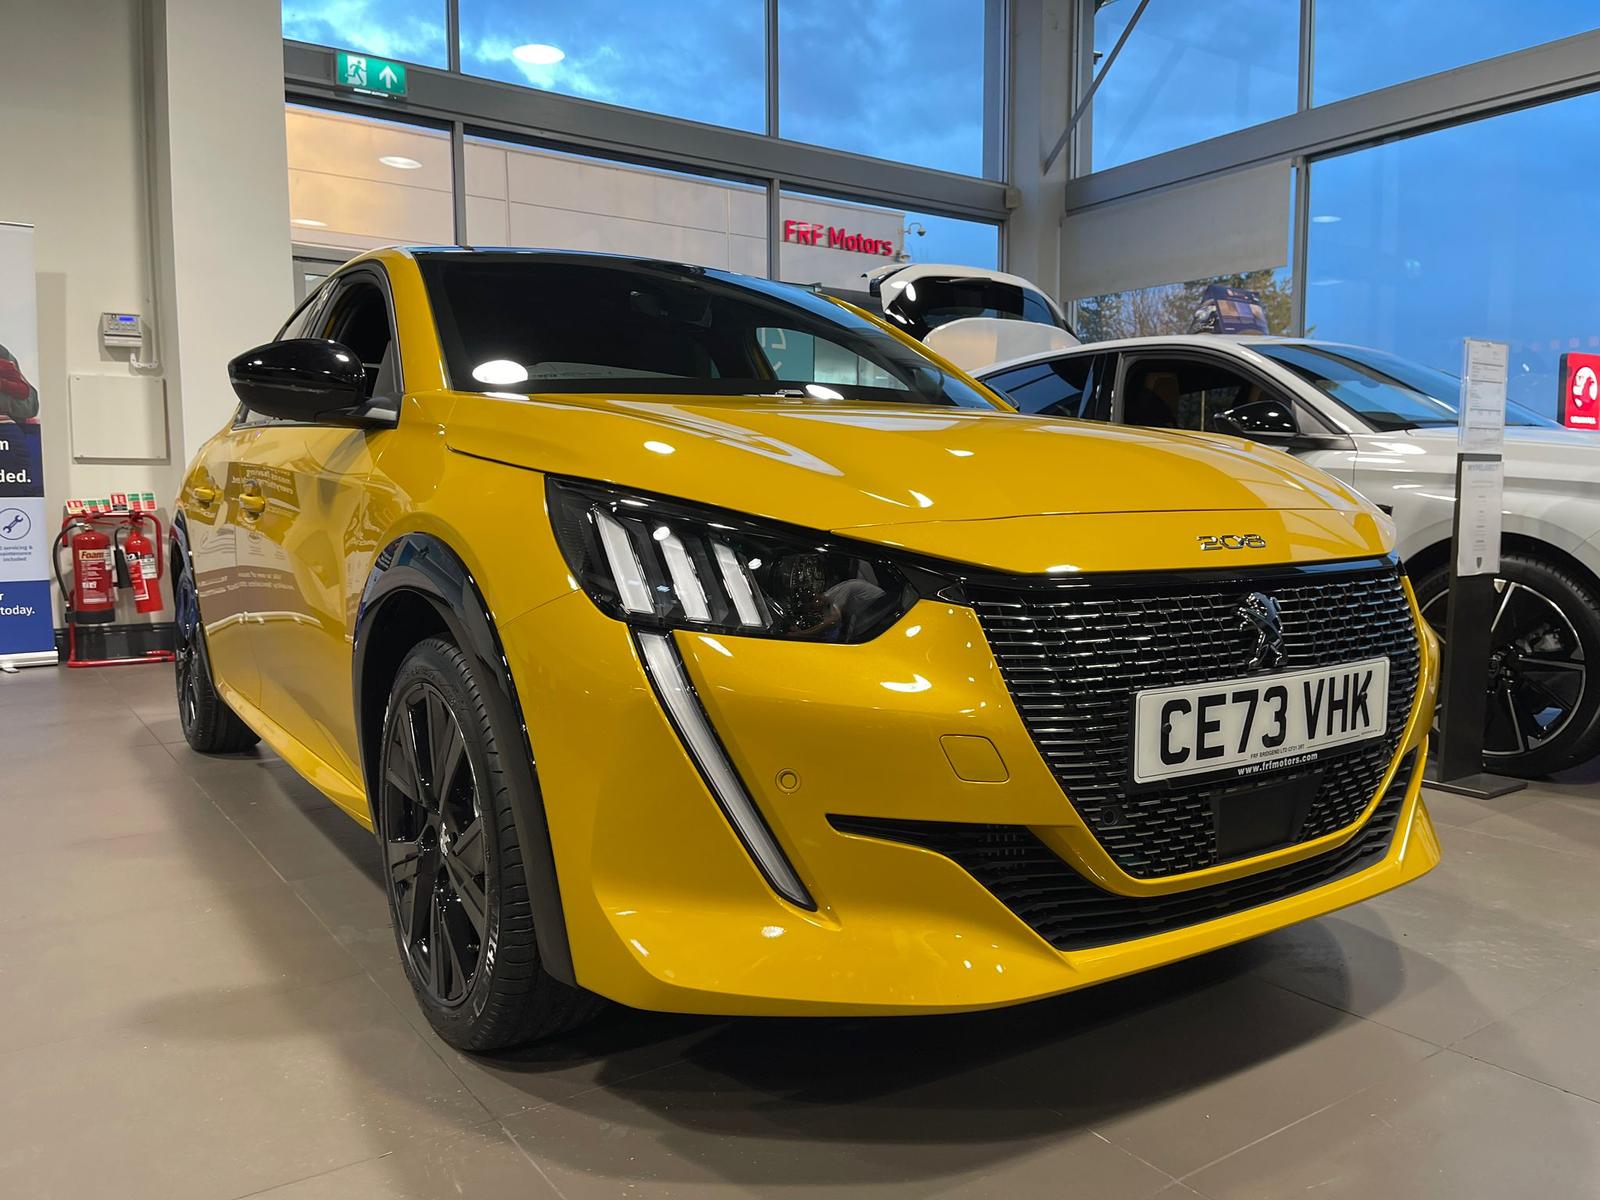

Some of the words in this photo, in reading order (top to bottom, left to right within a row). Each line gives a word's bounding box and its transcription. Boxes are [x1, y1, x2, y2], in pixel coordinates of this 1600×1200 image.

[784, 219, 824, 246] FRF
[828, 226, 893, 256] Motors
[1196, 533, 1266, 551] 208
[81, 551, 104, 559] Foam
[0, 605, 35, 616] today.
[1160, 685, 1288, 766] CE73
[1303, 670, 1373, 740] VHK
[1237, 752, 1318, 776] www.frfmotors.com
